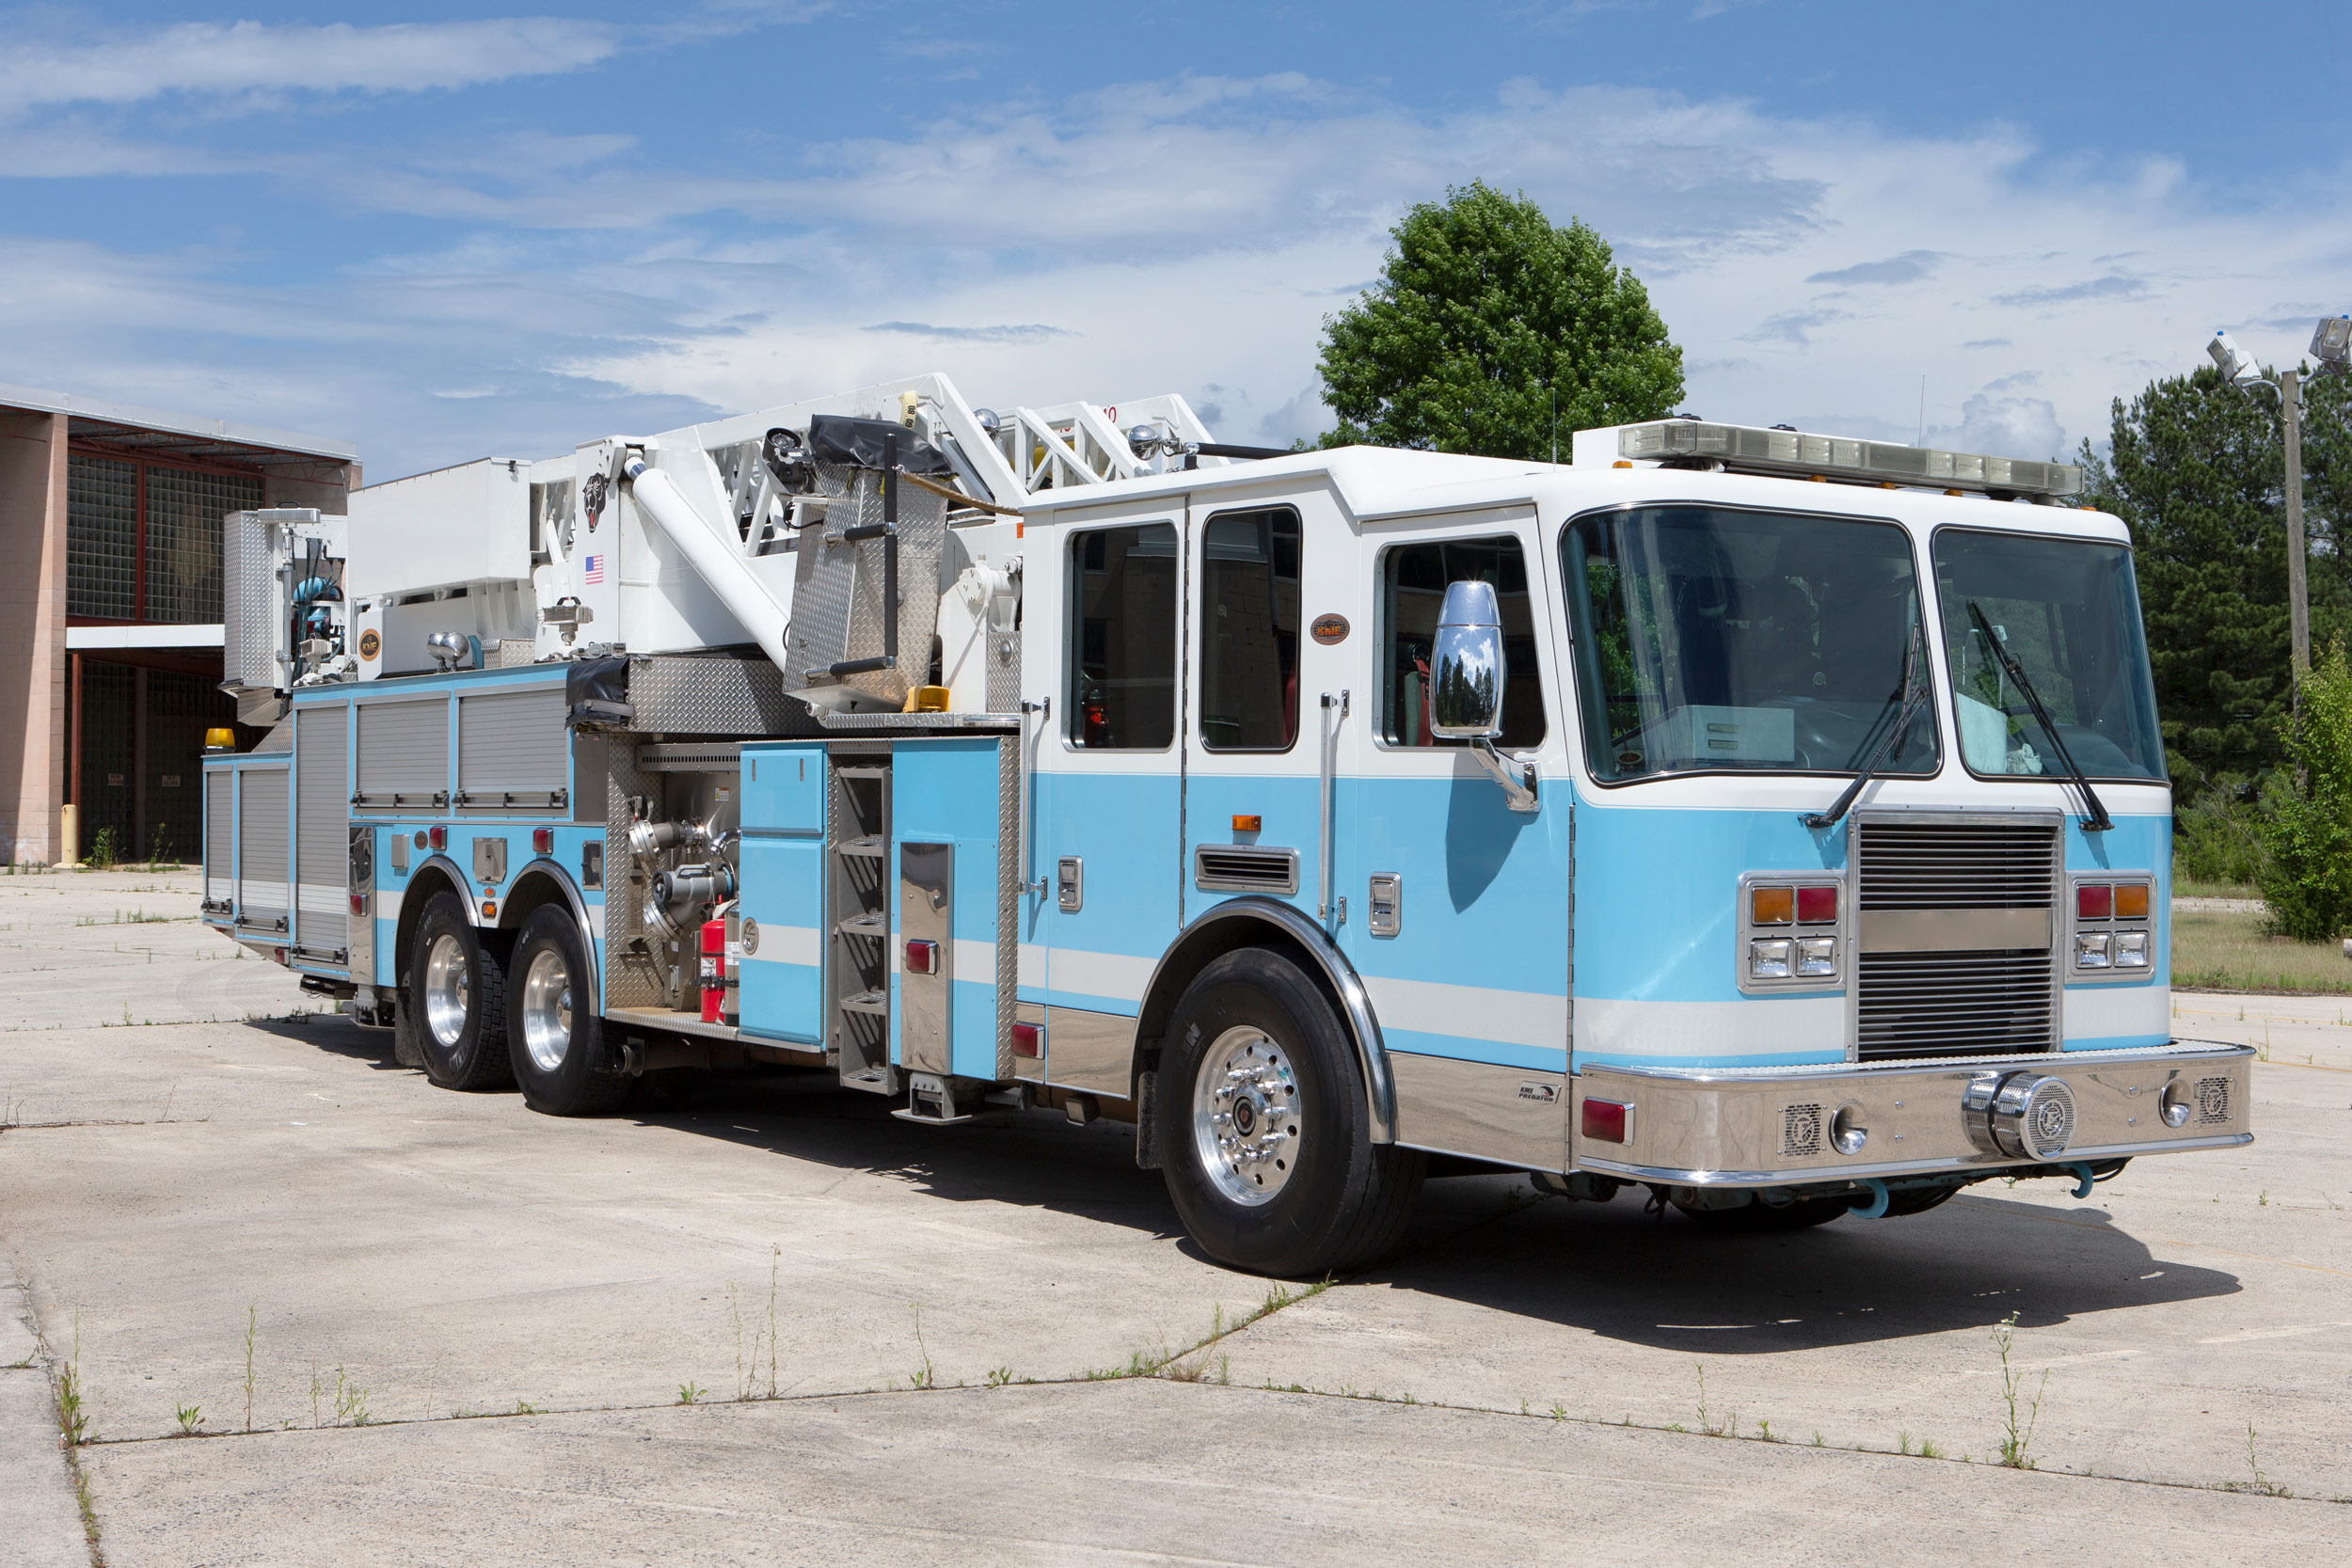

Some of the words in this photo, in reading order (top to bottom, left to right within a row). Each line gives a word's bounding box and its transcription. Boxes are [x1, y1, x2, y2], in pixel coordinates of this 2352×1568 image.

[908, 405, 915, 415] 80
[1316, 626, 1342, 637] KME
[362, 641, 377, 652] KME
[1518, 1093, 1554, 1102] PREDATOR
